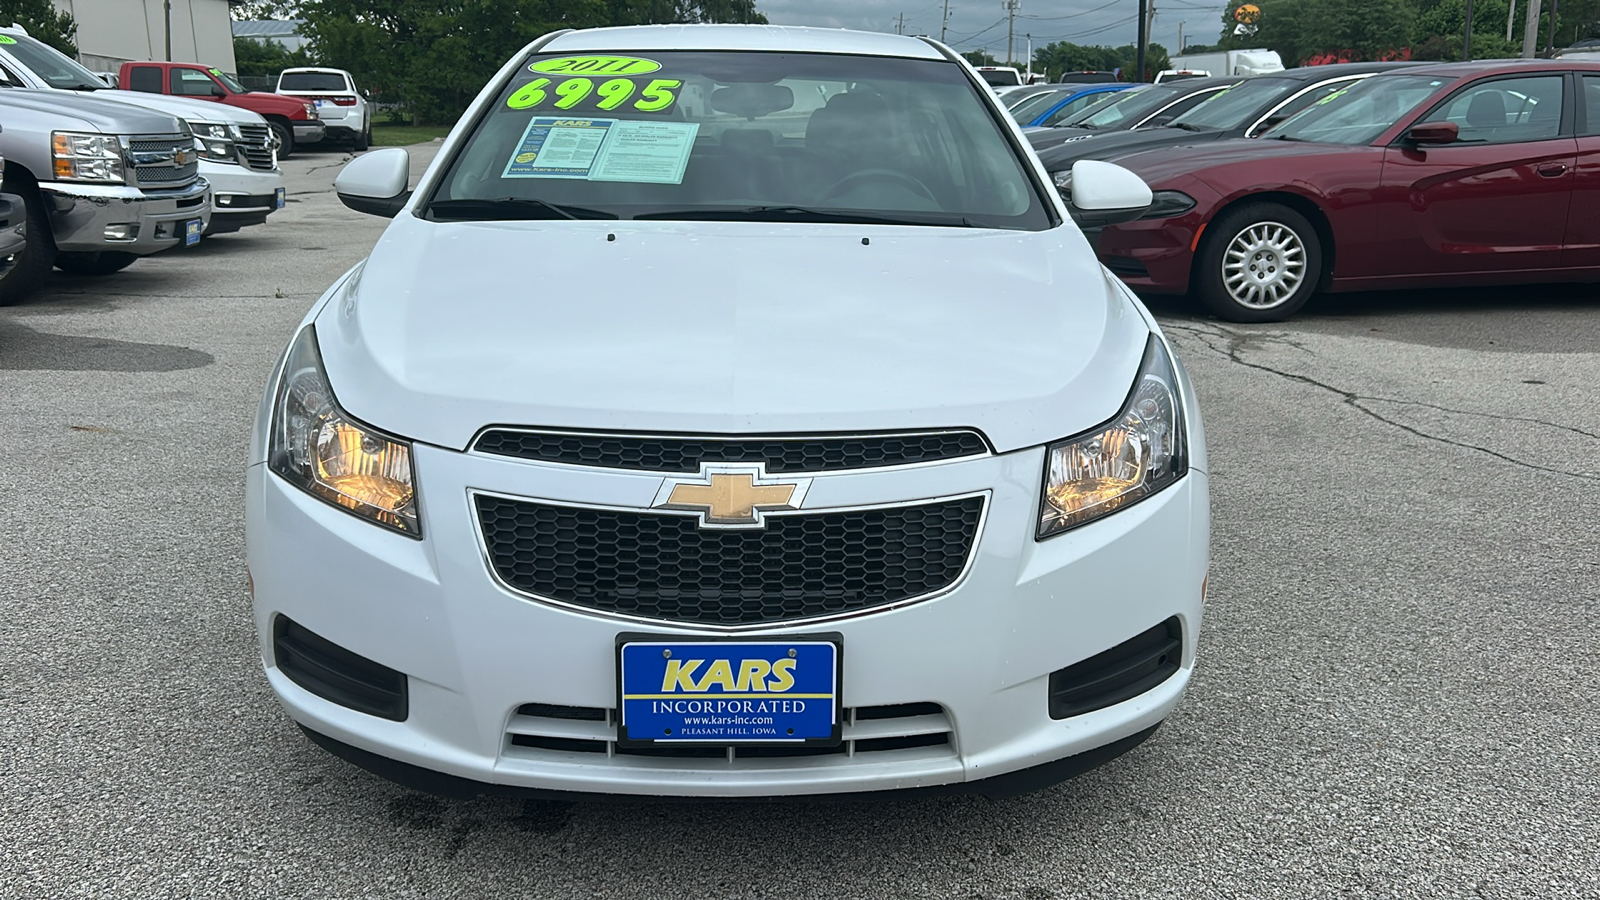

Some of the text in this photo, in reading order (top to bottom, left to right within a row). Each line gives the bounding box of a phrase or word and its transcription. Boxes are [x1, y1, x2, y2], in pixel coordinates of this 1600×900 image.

[549, 59, 640, 73] 2011
[506, 77, 682, 112] 6995
[552, 119, 594, 127] KARS
[661, 657, 797, 692] KARS
[652, 700, 806, 714] INCORPORATED
[684, 714, 773, 725] www.kars-inc.com
[681, 727, 724, 735] PLEASANT
[752, 727, 777, 735] IOWA
